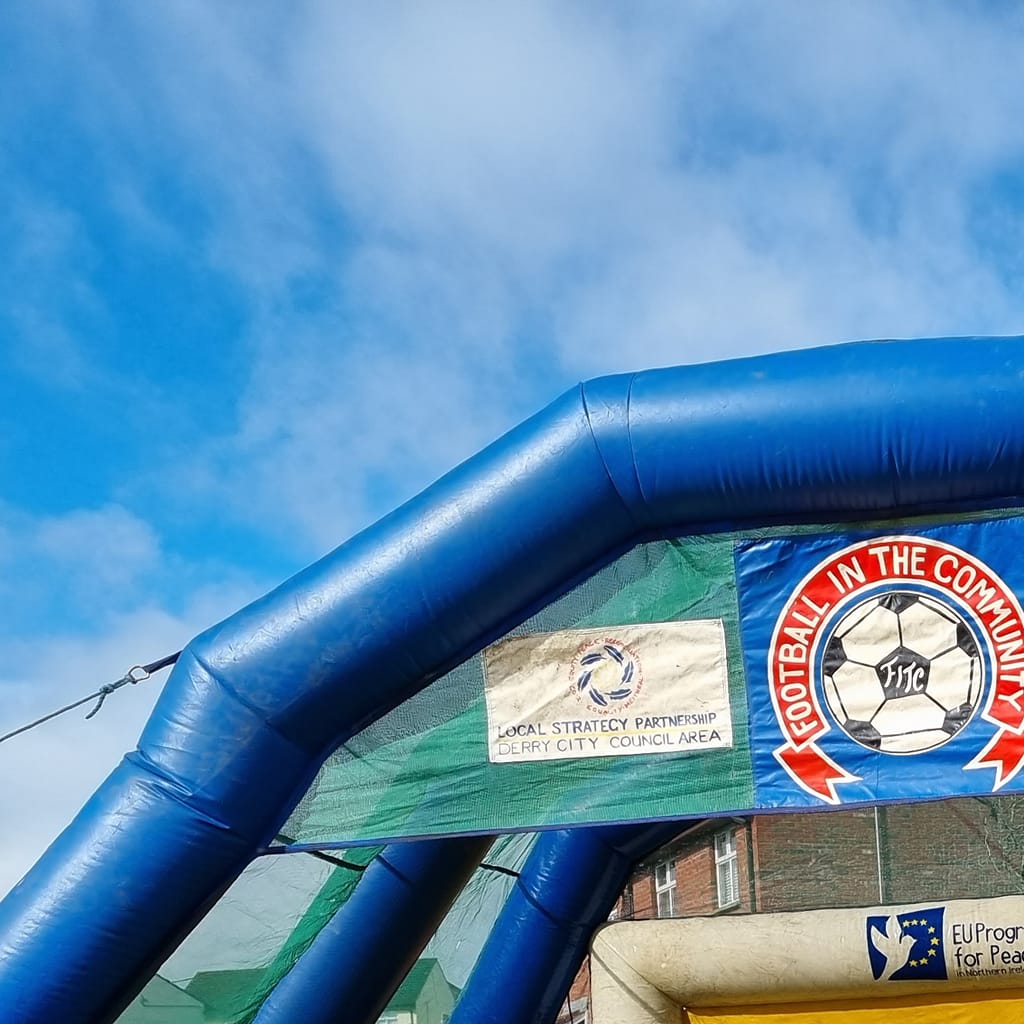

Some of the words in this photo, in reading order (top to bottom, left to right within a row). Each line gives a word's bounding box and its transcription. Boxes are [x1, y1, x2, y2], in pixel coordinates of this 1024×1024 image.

[779, 596, 830, 736] FOOTBALL
[827, 556, 866, 594] IN
[868, 545, 927, 576] THE
[880, 656, 924, 693] FITC
[498, 723, 546, 738] LOCAL
[635, 712, 717, 729] PARTNERSHIP
[498, 740, 551, 755] DERRY
[557, 737, 599, 752] CITY
[609, 733, 674, 749] COUNCIL
[678, 730, 721, 744] AREA
[953, 924, 972, 945] EU
[955, 946, 983, 967] for
[966, 966, 1007, 977] Northern
